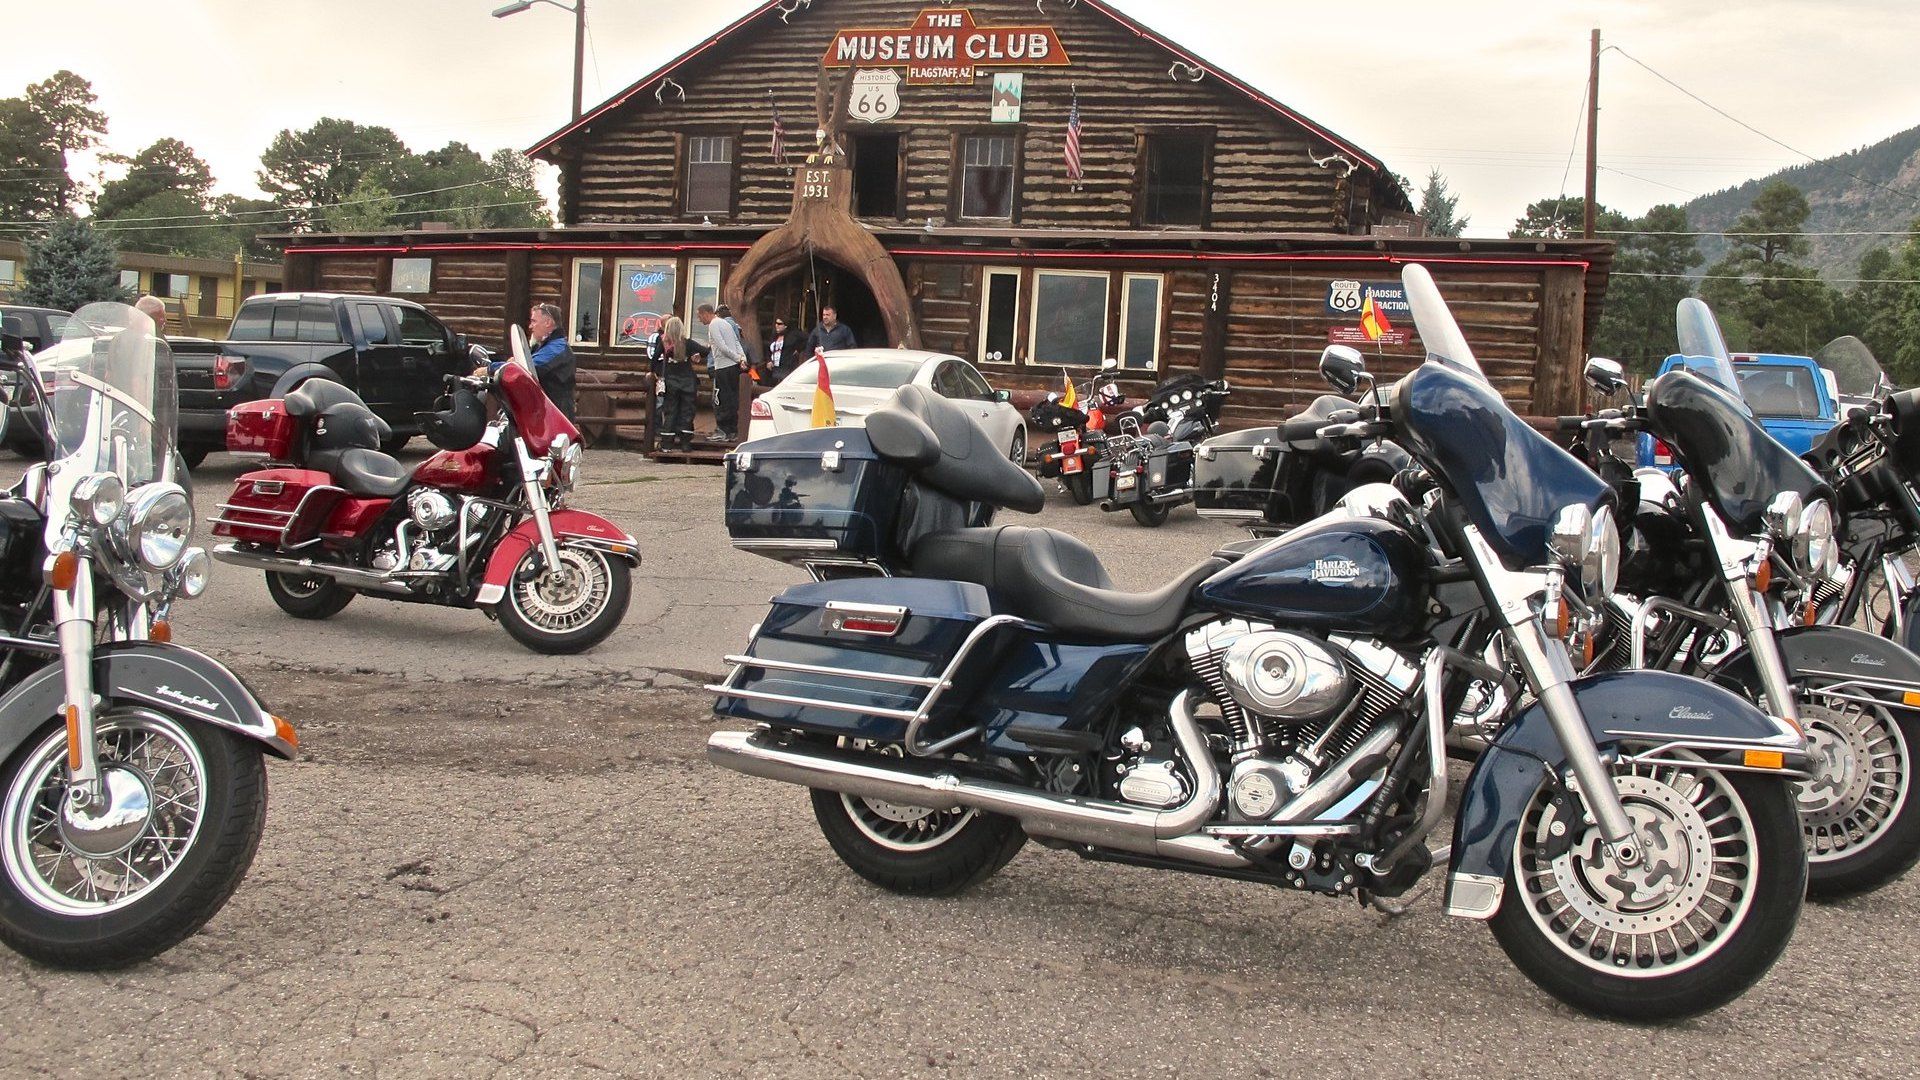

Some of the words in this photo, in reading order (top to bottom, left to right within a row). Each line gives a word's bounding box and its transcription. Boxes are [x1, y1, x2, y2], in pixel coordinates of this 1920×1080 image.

[927, 14, 962, 27] THE
[837, 34, 954, 60] MUSEUM
[965, 33, 1048, 59] CLUB
[910, 67, 958, 79] FLAGSTAFF,
[858, 94, 887, 113] 66
[806, 170, 831, 183] EST.
[802, 185, 829, 197] 1931
[630, 272, 665, 290] Coors
[1211, 273, 1220, 311] 3404
[1334, 291, 1357, 308] 66
[1315, 560, 1355, 570] HARLEY-
[1312, 568, 1360, 579] DAVIDSON
[1669, 706, 1714, 720] Classic
